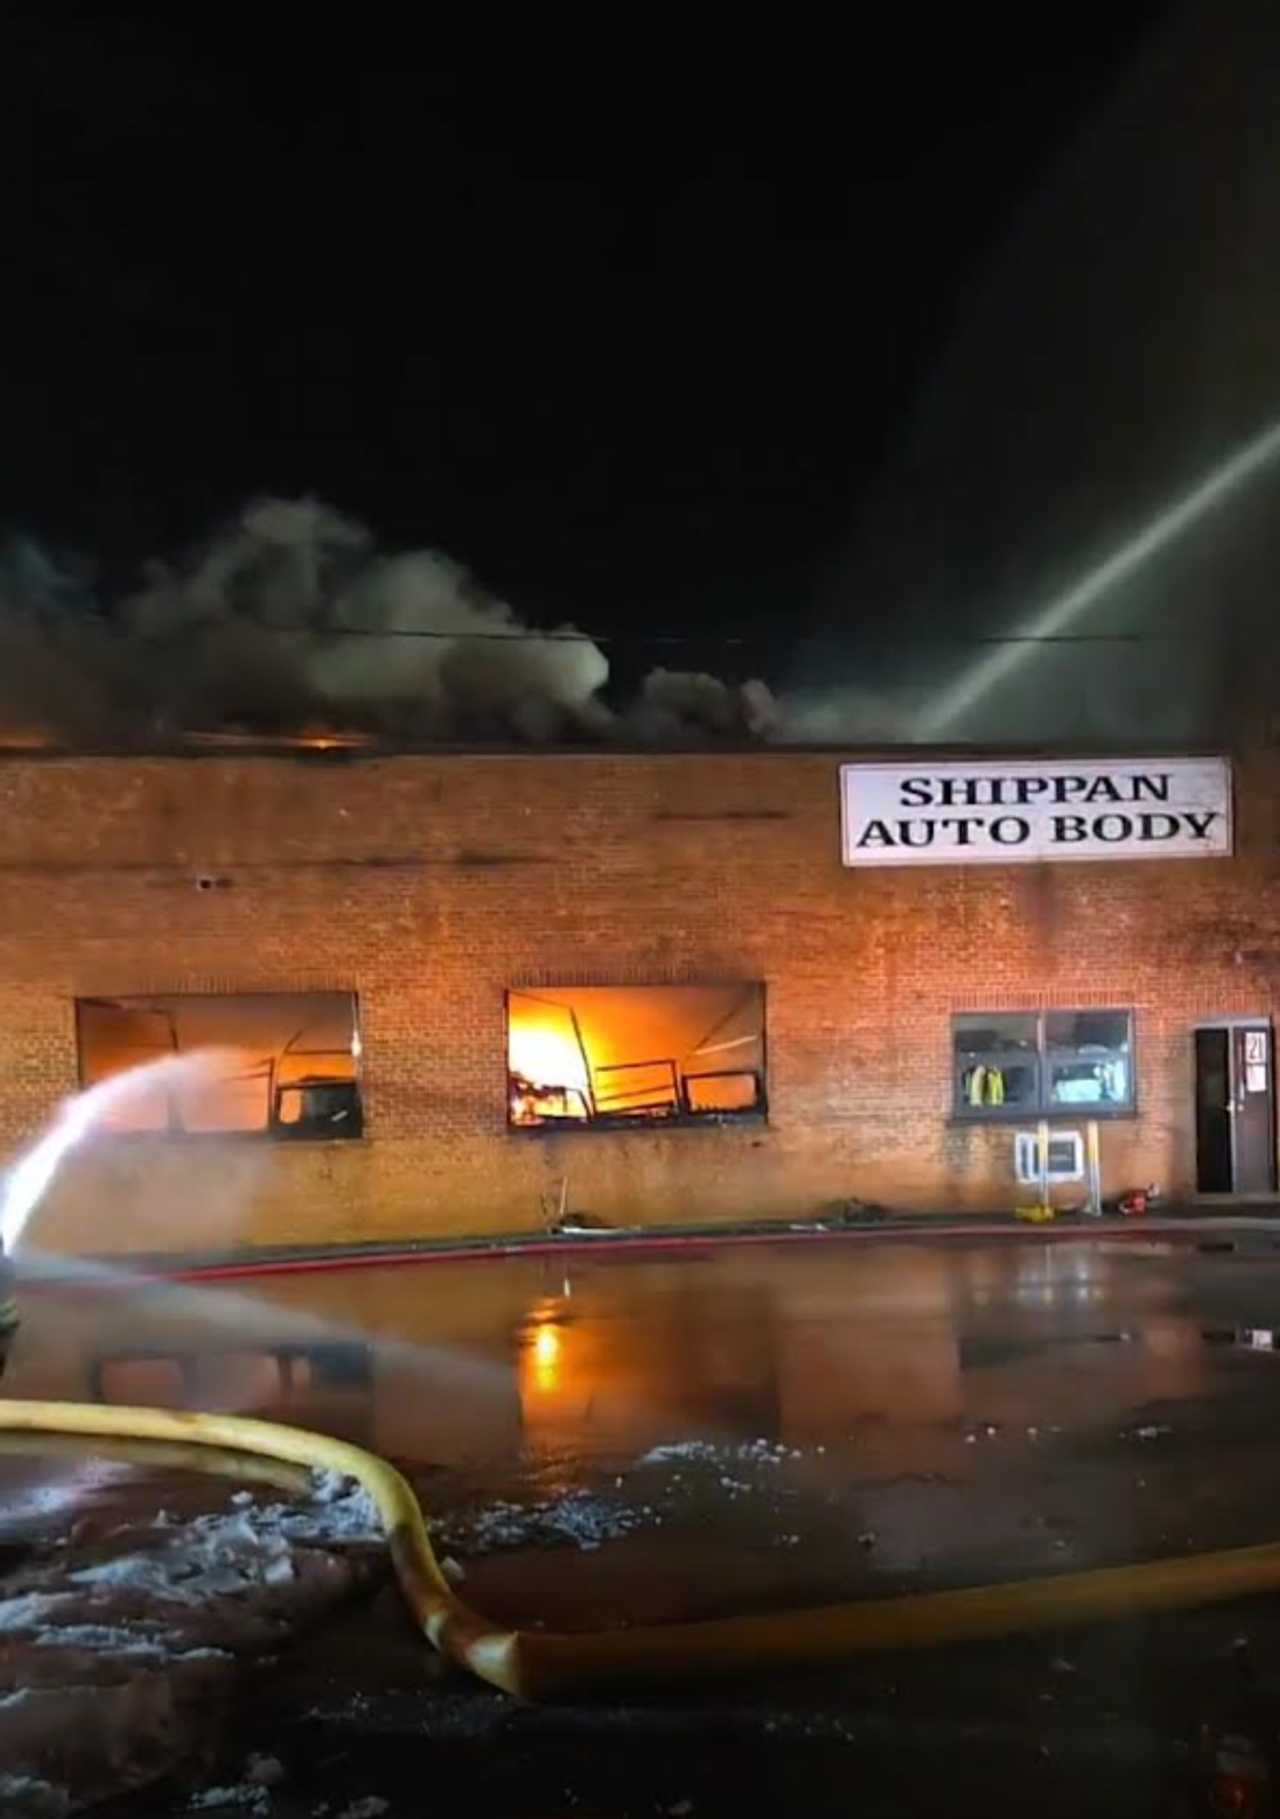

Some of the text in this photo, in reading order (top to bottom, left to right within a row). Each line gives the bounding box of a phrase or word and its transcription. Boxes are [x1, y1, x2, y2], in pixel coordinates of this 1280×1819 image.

[899, 773, 1173, 807] SHIPPAN
[856, 811, 1221, 848] AUTO BODY
